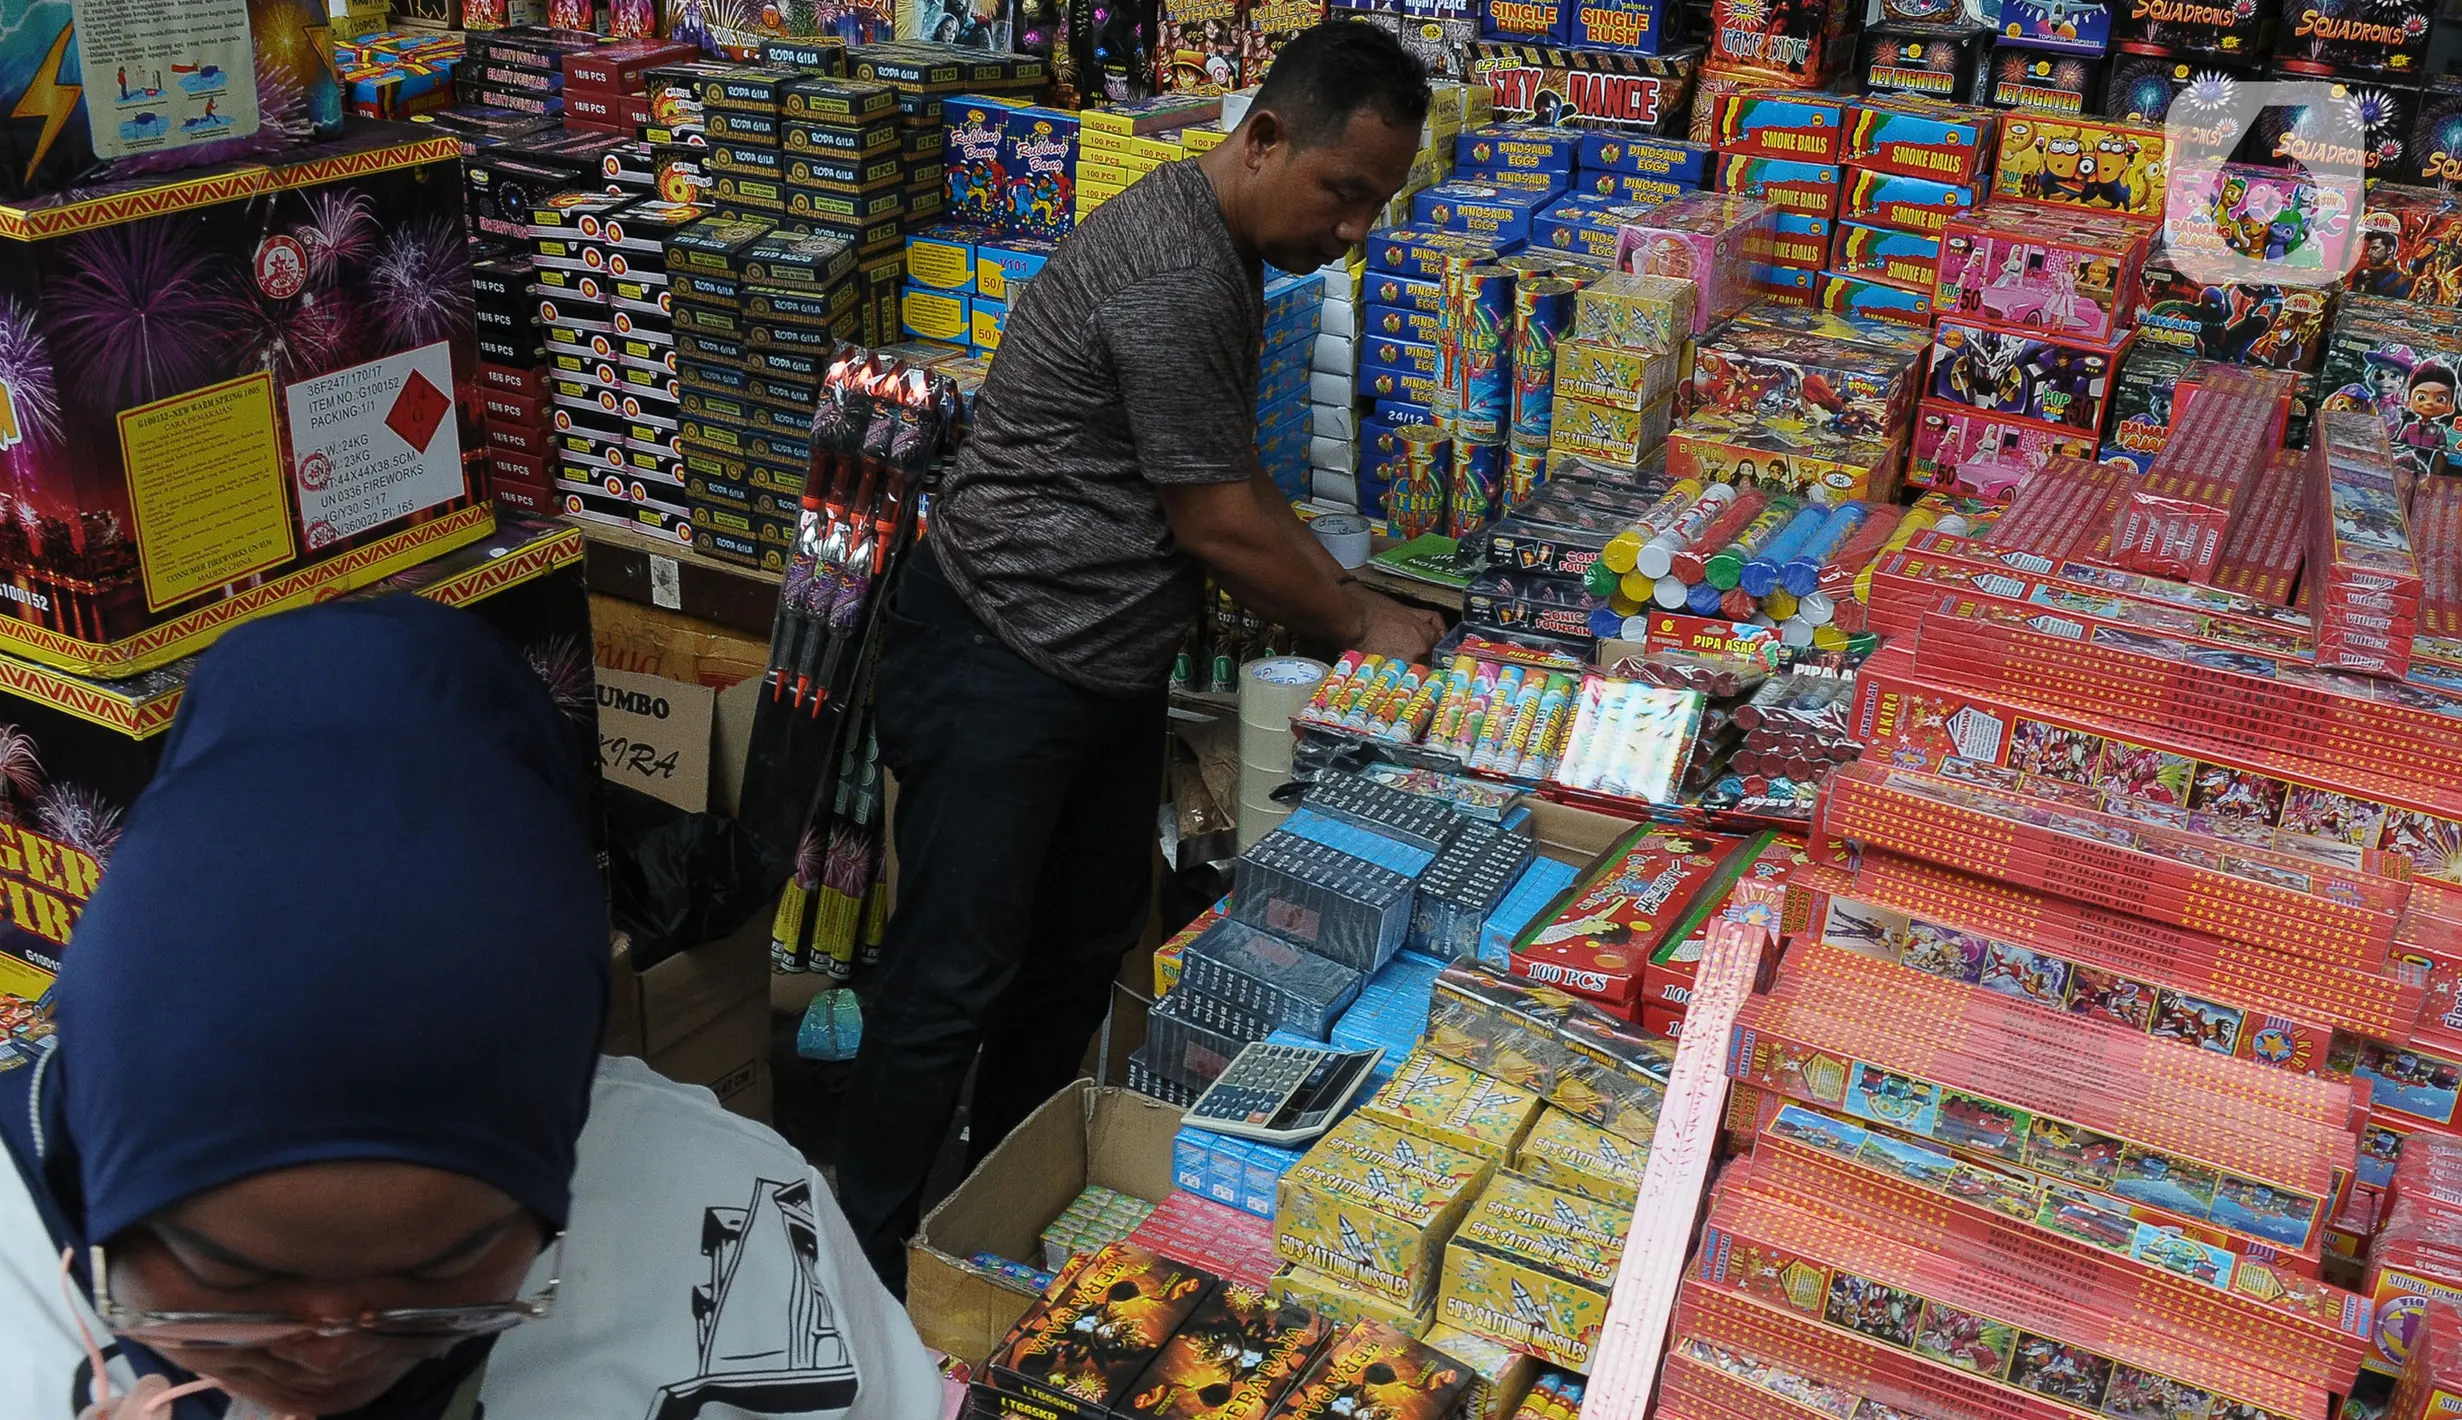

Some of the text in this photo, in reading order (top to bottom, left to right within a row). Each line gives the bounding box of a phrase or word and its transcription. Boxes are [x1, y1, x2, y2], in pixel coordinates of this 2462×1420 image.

[1176, 5, 1236, 24] WHALE
[1251, 2, 1310, 21] KILLER
[1490, 1, 1558, 23] SINGLE
[1581, 10, 1650, 31] SINGLE
[1260, 13, 1322, 34] WHALE
[1496, 16, 1550, 35] RUSH
[1587, 25, 1639, 46] RUSH
[1721, 27, 1809, 64] GAME KING
[769, 48, 818, 65] RODA GILA
[574, 70, 606, 82] 18/6 PCS
[878, 66, 919, 80] RODA GILA
[1868, 66, 1953, 93] JET FIGHTER
[728, 86, 769, 99] RODA GILA
[1487, 67, 1661, 123] SKY DANCE
[1995, 83, 2082, 112] JET FIGHTER
[731, 118, 771, 132] RODA GILA
[1091, 121, 1122, 133] 100 PCS
[812, 133, 855, 147] RODA GILA
[951, 130, 1001, 147] Rubbing
[1090, 134, 1121, 148] 100 PCS
[1762, 130, 1827, 154] SMOKE BALLS
[963, 145, 997, 161] Bang
[1016, 143, 1069, 160] Rubbing
[1140, 148, 1171, 160] 100 PCS
[1498, 141, 1553, 157] DINOSAUR
[1628, 144, 1686, 164] DINOSAUR
[1029, 157, 1063, 172] Bang
[1508, 155, 1539, 168] EGGS
[1637, 160, 1669, 174] EGGS
[1892, 146, 1963, 173] SMOKE BALLS
[813, 165, 854, 180] RODA GILA
[1086, 169, 1116, 181] 100 PCS
[1623, 176, 1680, 197] DINOSAUR
[1632, 192, 1663, 205] EGGS
[1768, 188, 1827, 210] SMOKE BALLS
[1458, 205, 1514, 222] DINOSAUR
[1891, 206, 1926, 226] SMOKE
[2373, 216, 2390, 228] SUN
[1468, 219, 1498, 232] EGGS
[472, 279, 505, 293] 18/6 PCS
[1940, 283, 1981, 311] POP 50
[2293, 297, 2310, 309] SUN
[774, 301, 821, 314] RODA GILA
[477, 312, 511, 325] 18/6 PCS
[2139, 314, 2200, 332] BAWANG
[480, 342, 514, 357] 18/6 PCS
[1607, 387, 1637, 404] MISSILES
[2043, 389, 2071, 406] POP
[309, 398, 335, 413] ITEM
[509, 435, 525, 448] PCS
[321, 464, 424, 508] UN 0336 FIREWORKS
[518, 494, 534, 508] PCS
[716, 537, 736, 549] RODA
[1535, 619, 1592, 638] FOUNTAIN
[1693, 634, 1757, 655] PIPA ASAP
[1507, 650, 1535, 660] PIPA
[596, 684, 670, 719] UMBO
[1877, 692, 1899, 737] AKIRA
[1526, 709, 1548, 748] GREEN
[1528, 962, 1608, 992] 100 PCS
[1354, 1145, 1405, 1171] SATTURN
[1403, 1163, 1456, 1190] MISSILES
[1560, 1146, 1614, 1173] SATTURN
[1615, 1164, 1644, 1183] MISS
[1514, 1209, 1574, 1236] SATTURN
[1572, 1226, 1626, 1251] MISSILES
[1306, 1244, 1356, 1278] SATTURN
[1357, 1263, 1409, 1299] MISSILES
[2387, 1273, 2429, 1295] SUPER
[1023, 1262, 1127, 1356] KERA RAJA
[1446, 1297, 1588, 1364] 50'S SATTURN MISSILES
[1256, 1327, 1308, 1379] RAJA
[1325, 1338, 1382, 1386] KERA
